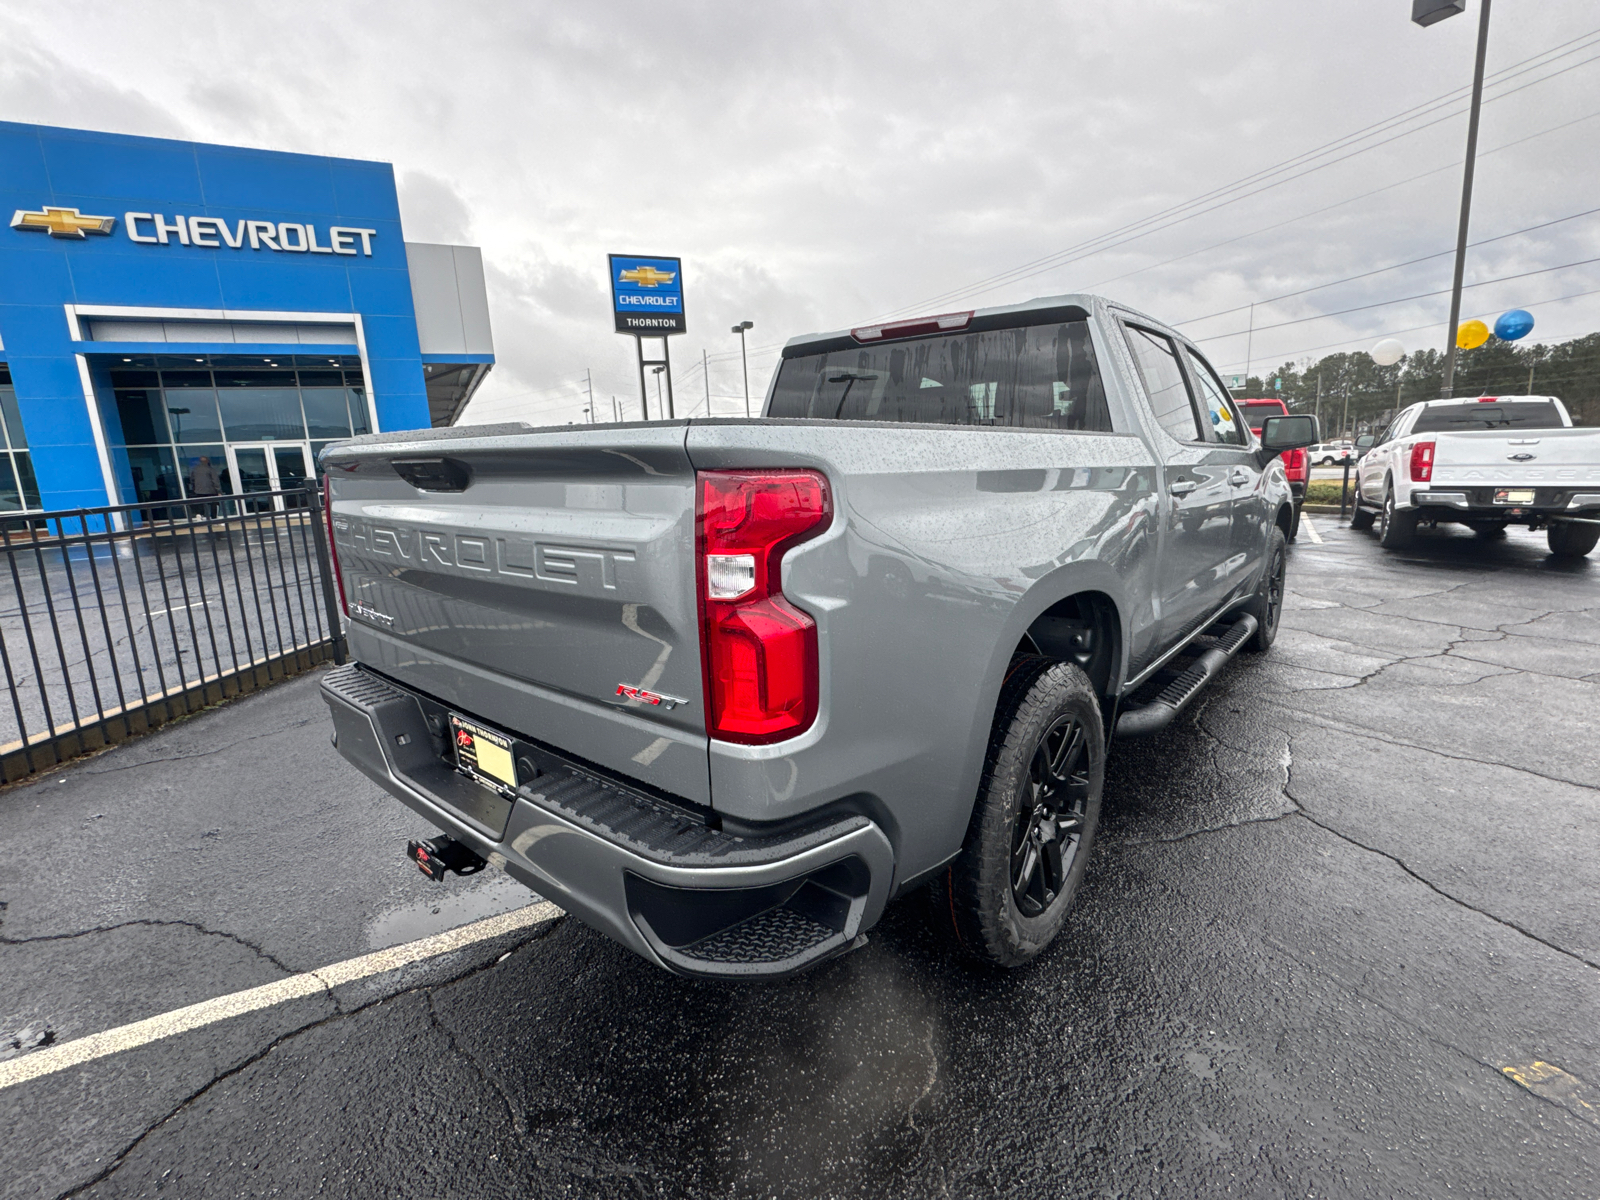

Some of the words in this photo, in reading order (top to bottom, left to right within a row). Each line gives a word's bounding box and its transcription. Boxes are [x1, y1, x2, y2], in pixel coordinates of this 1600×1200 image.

[124, 211, 377, 256] CHEVROLET
[619, 295, 678, 306] CHEVROLET
[626, 318, 676, 327] THORNTON
[333, 516, 637, 590] CHEVROLET
[615, 683, 690, 710] RST
